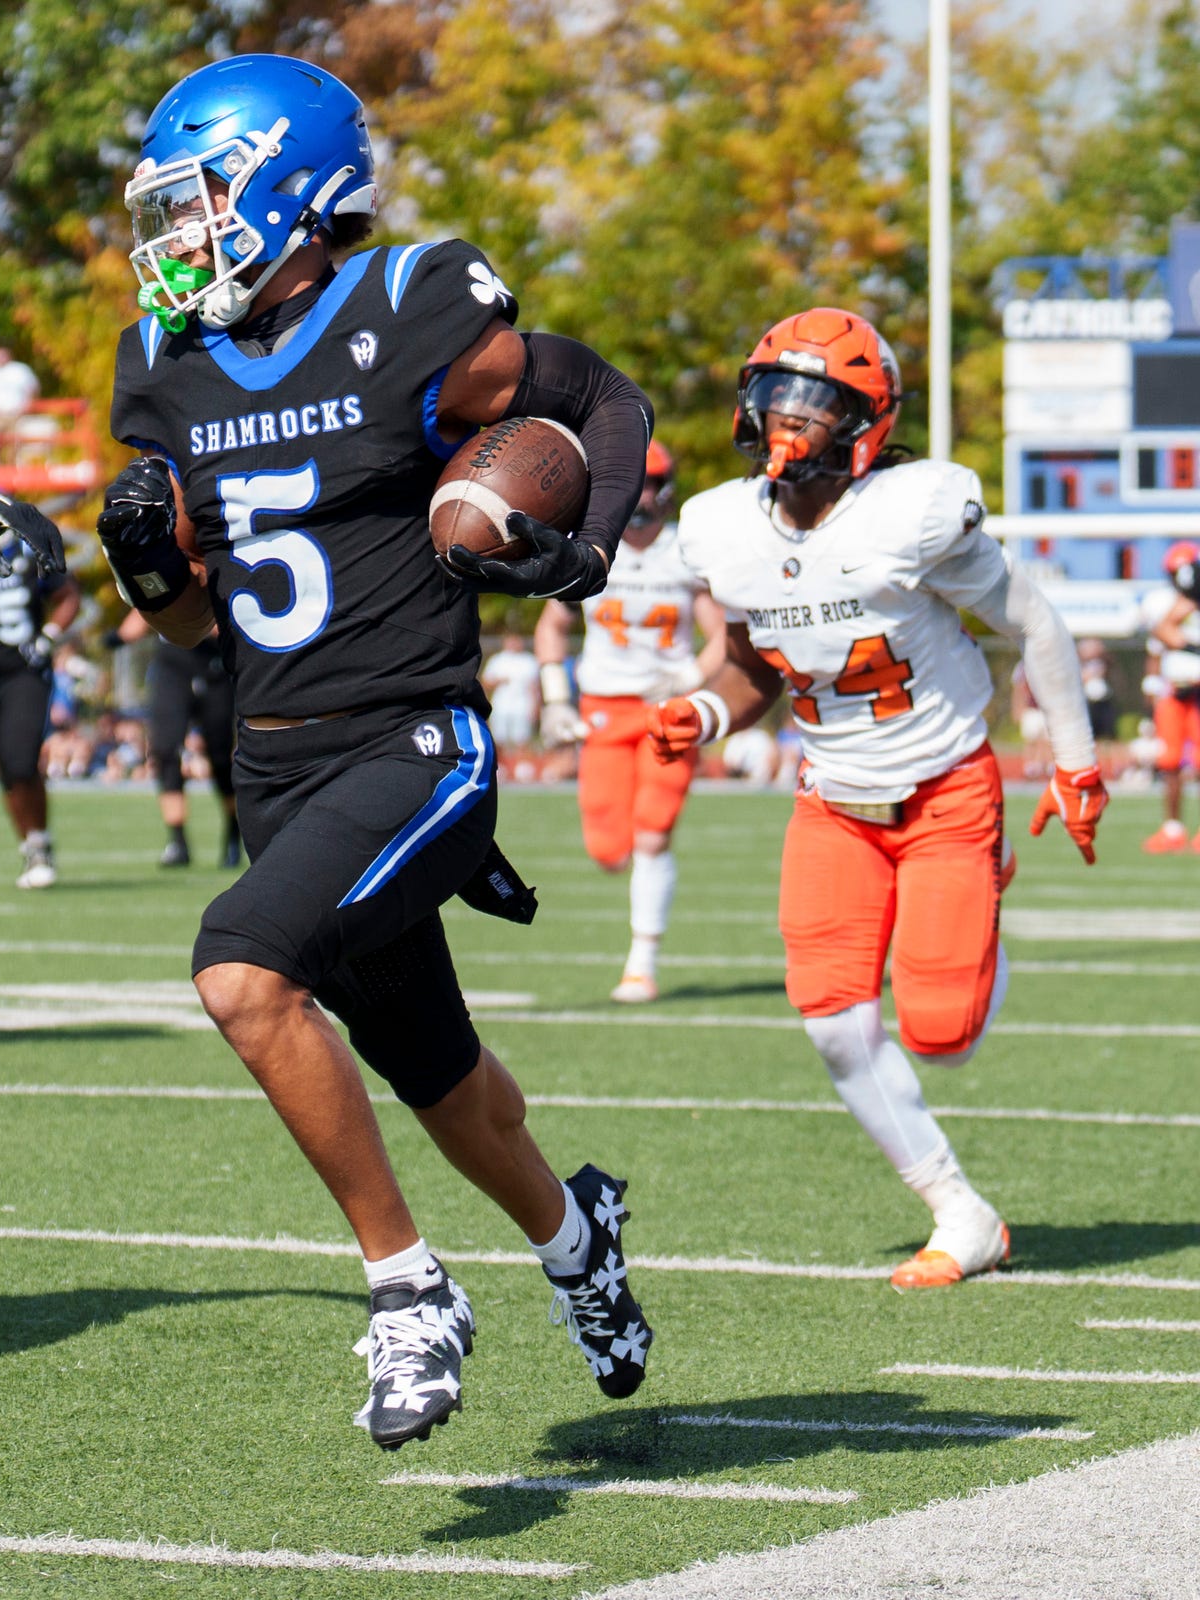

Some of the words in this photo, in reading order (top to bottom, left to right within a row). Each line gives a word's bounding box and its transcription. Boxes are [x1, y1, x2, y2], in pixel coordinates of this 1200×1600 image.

[189, 393, 363, 456] SHAMROCKS
[216, 457, 334, 653] 5
[594, 599, 679, 650] 44
[746, 604, 814, 629] BROTHER
[820, 598, 864, 625] RICE
